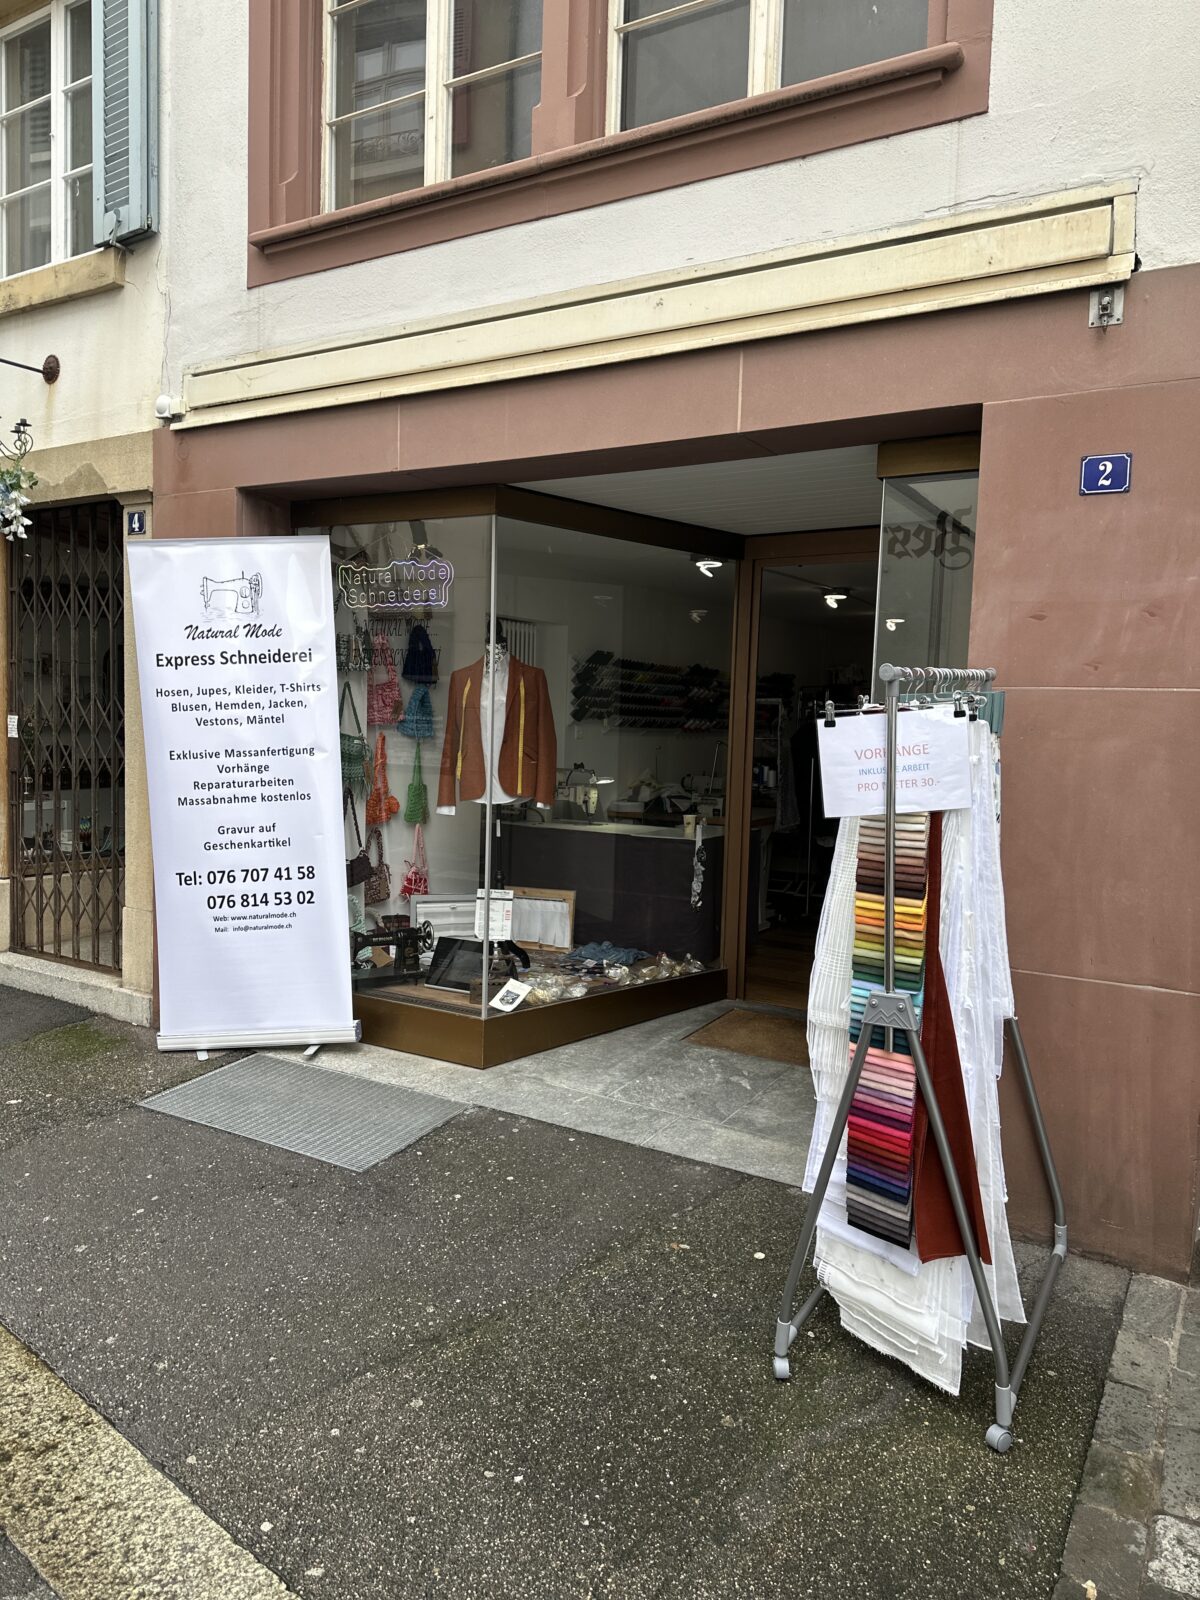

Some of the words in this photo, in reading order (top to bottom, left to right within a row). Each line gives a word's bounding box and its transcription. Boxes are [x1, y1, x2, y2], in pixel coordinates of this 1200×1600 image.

[1098, 461, 1113, 486] 2
[132, 513, 140, 531] 4
[342, 566, 397, 585] Natural
[403, 565, 447, 582] Mode
[349, 585, 441, 604] Schneiderei
[184, 624, 240, 640] Natural
[243, 623, 282, 638] Mode
[156, 653, 215, 670] Express
[220, 648, 312, 666] Schneiderei
[156, 687, 193, 698] Hosen,
[196, 686, 231, 697] Jupes,
[235, 684, 276, 695] Kleider,
[280, 682, 321, 693] T-Shirts
[171, 702, 211, 712] Blusen,
[215, 700, 265, 711] Hemden,
[268, 699, 308, 709] Jacken,
[196, 716, 243, 727] Vestons,
[247, 714, 285, 725] Mäntel
[169, 748, 221, 760] Exklusive
[224, 746, 315, 759] Massanfertigung
[217, 763, 270, 774] Vorhänge
[859, 765, 900, 776] INKLUSE
[902, 763, 930, 772] ARBEIT
[193, 777, 294, 791] Reparaturarbeiten
[857, 782, 879, 792] PRO
[921, 777, 941, 787] 30.-
[178, 793, 257, 806] Massabnahme
[260, 791, 311, 802] kostenlos
[217, 825, 255, 835] Gravur
[258, 823, 276, 833] auf
[204, 837, 291, 851] Geschenkartikel
[176, 871, 202, 886] Tel:
[207, 870, 236, 885] 076
[240, 868, 269, 883] 707
[274, 866, 292, 881] 41
[297, 865, 315, 880] 58
[207, 895, 236, 910] 076
[240, 893, 269, 908] 814
[274, 891, 292, 906] 53
[297, 890, 315, 905] 02
[231, 911, 297, 921] www.naturalmode.ch
[233, 923, 292, 932] info@naturalmode.ch
